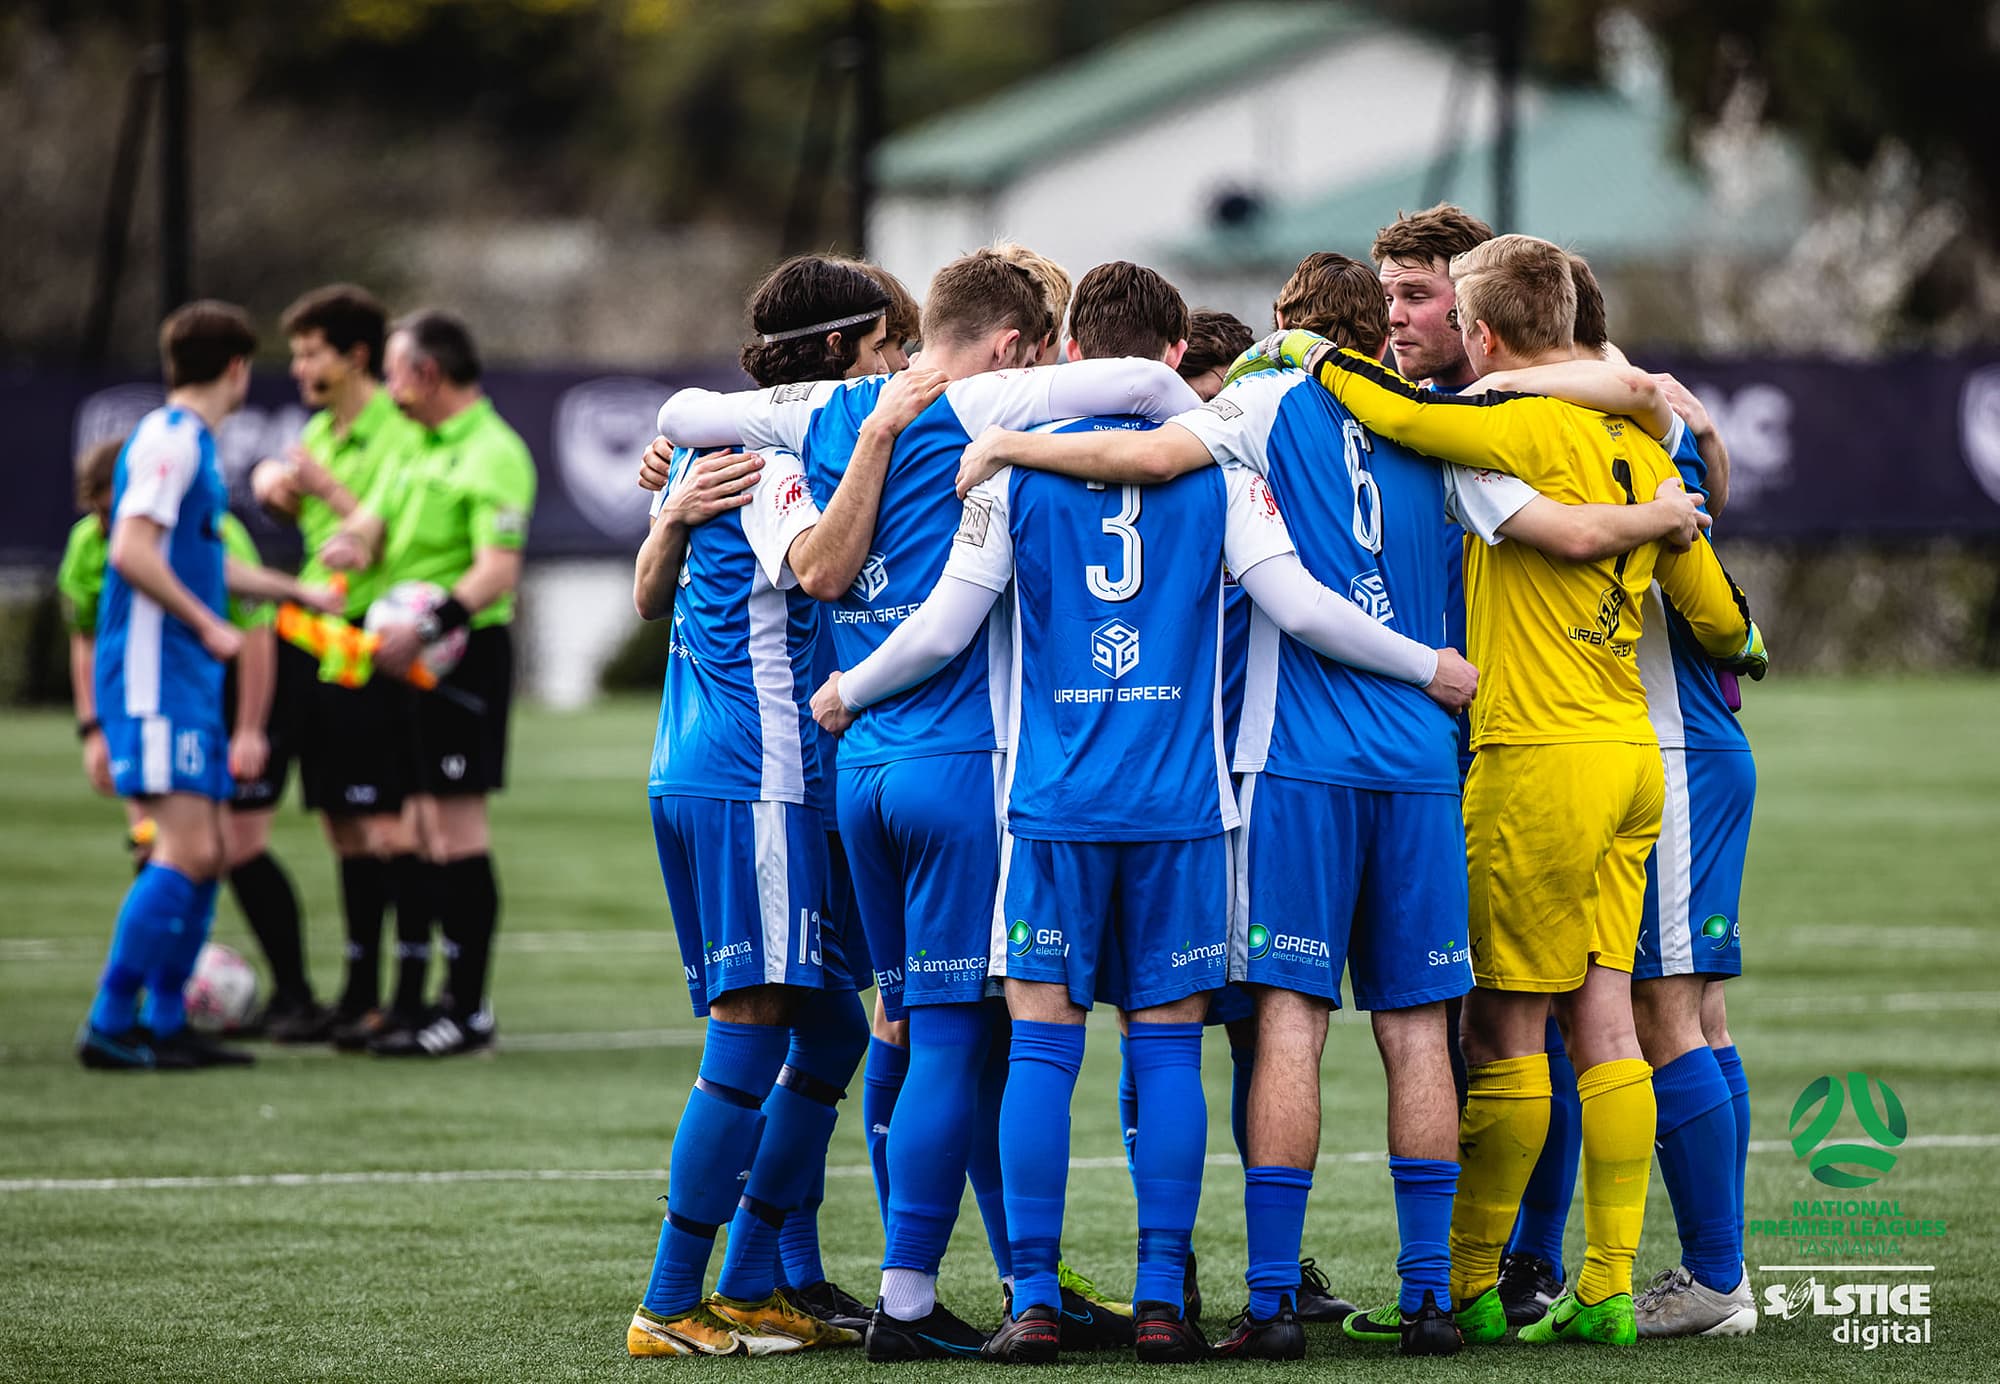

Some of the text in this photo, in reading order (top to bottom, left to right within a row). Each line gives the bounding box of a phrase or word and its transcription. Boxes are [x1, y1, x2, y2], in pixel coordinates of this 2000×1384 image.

[1343, 418, 1383, 555] 6
[1086, 482, 1143, 602] 3
[1568, 626, 1606, 646] URB
[1054, 686, 1182, 704] URBAN GREEK
[799, 908, 823, 967] 13
[1274, 934, 1330, 958] GREEN
[1036, 945, 1064, 956] electr
[1272, 951, 1329, 969] electrical tas
